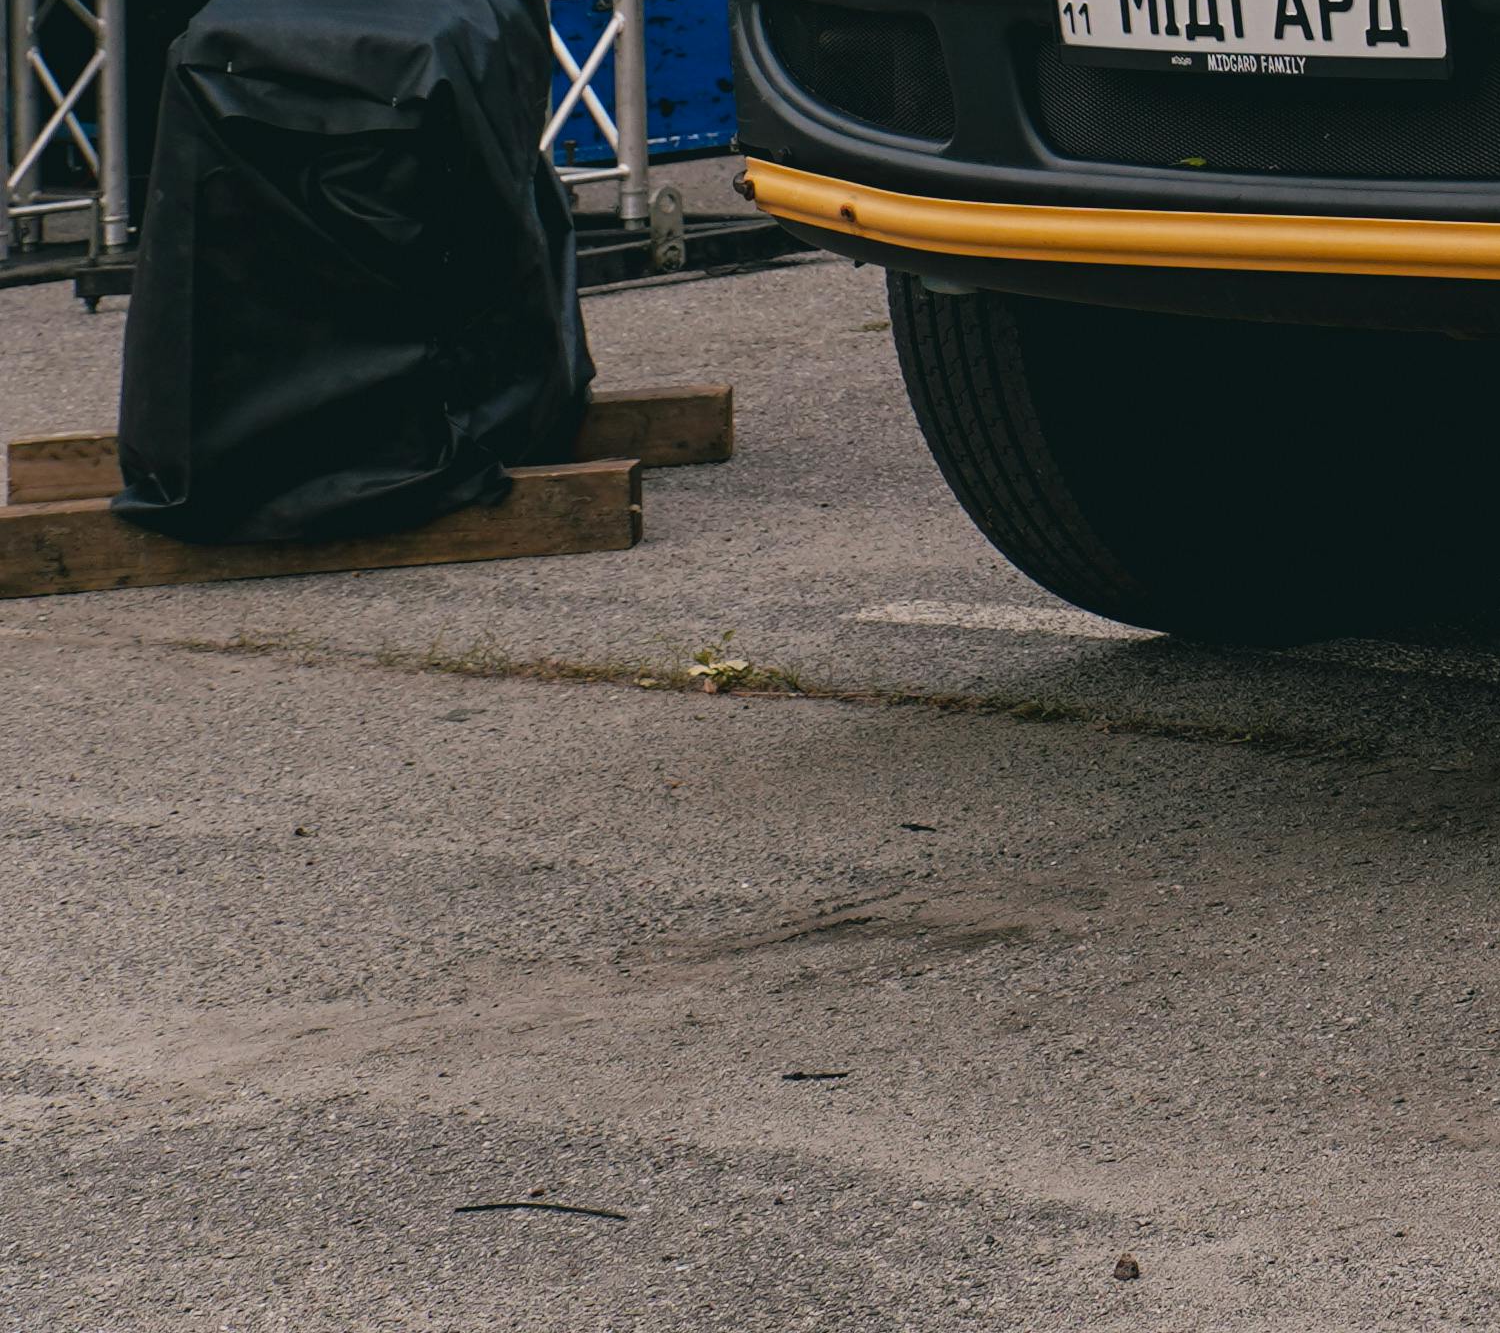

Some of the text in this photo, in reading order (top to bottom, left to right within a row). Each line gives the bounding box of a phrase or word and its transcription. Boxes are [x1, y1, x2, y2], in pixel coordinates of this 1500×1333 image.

[1063, 1, 1092, 36] 11
[1207, 53, 1257, 73] MIDGARD
[1260, 55, 1306, 74] FAMILY
